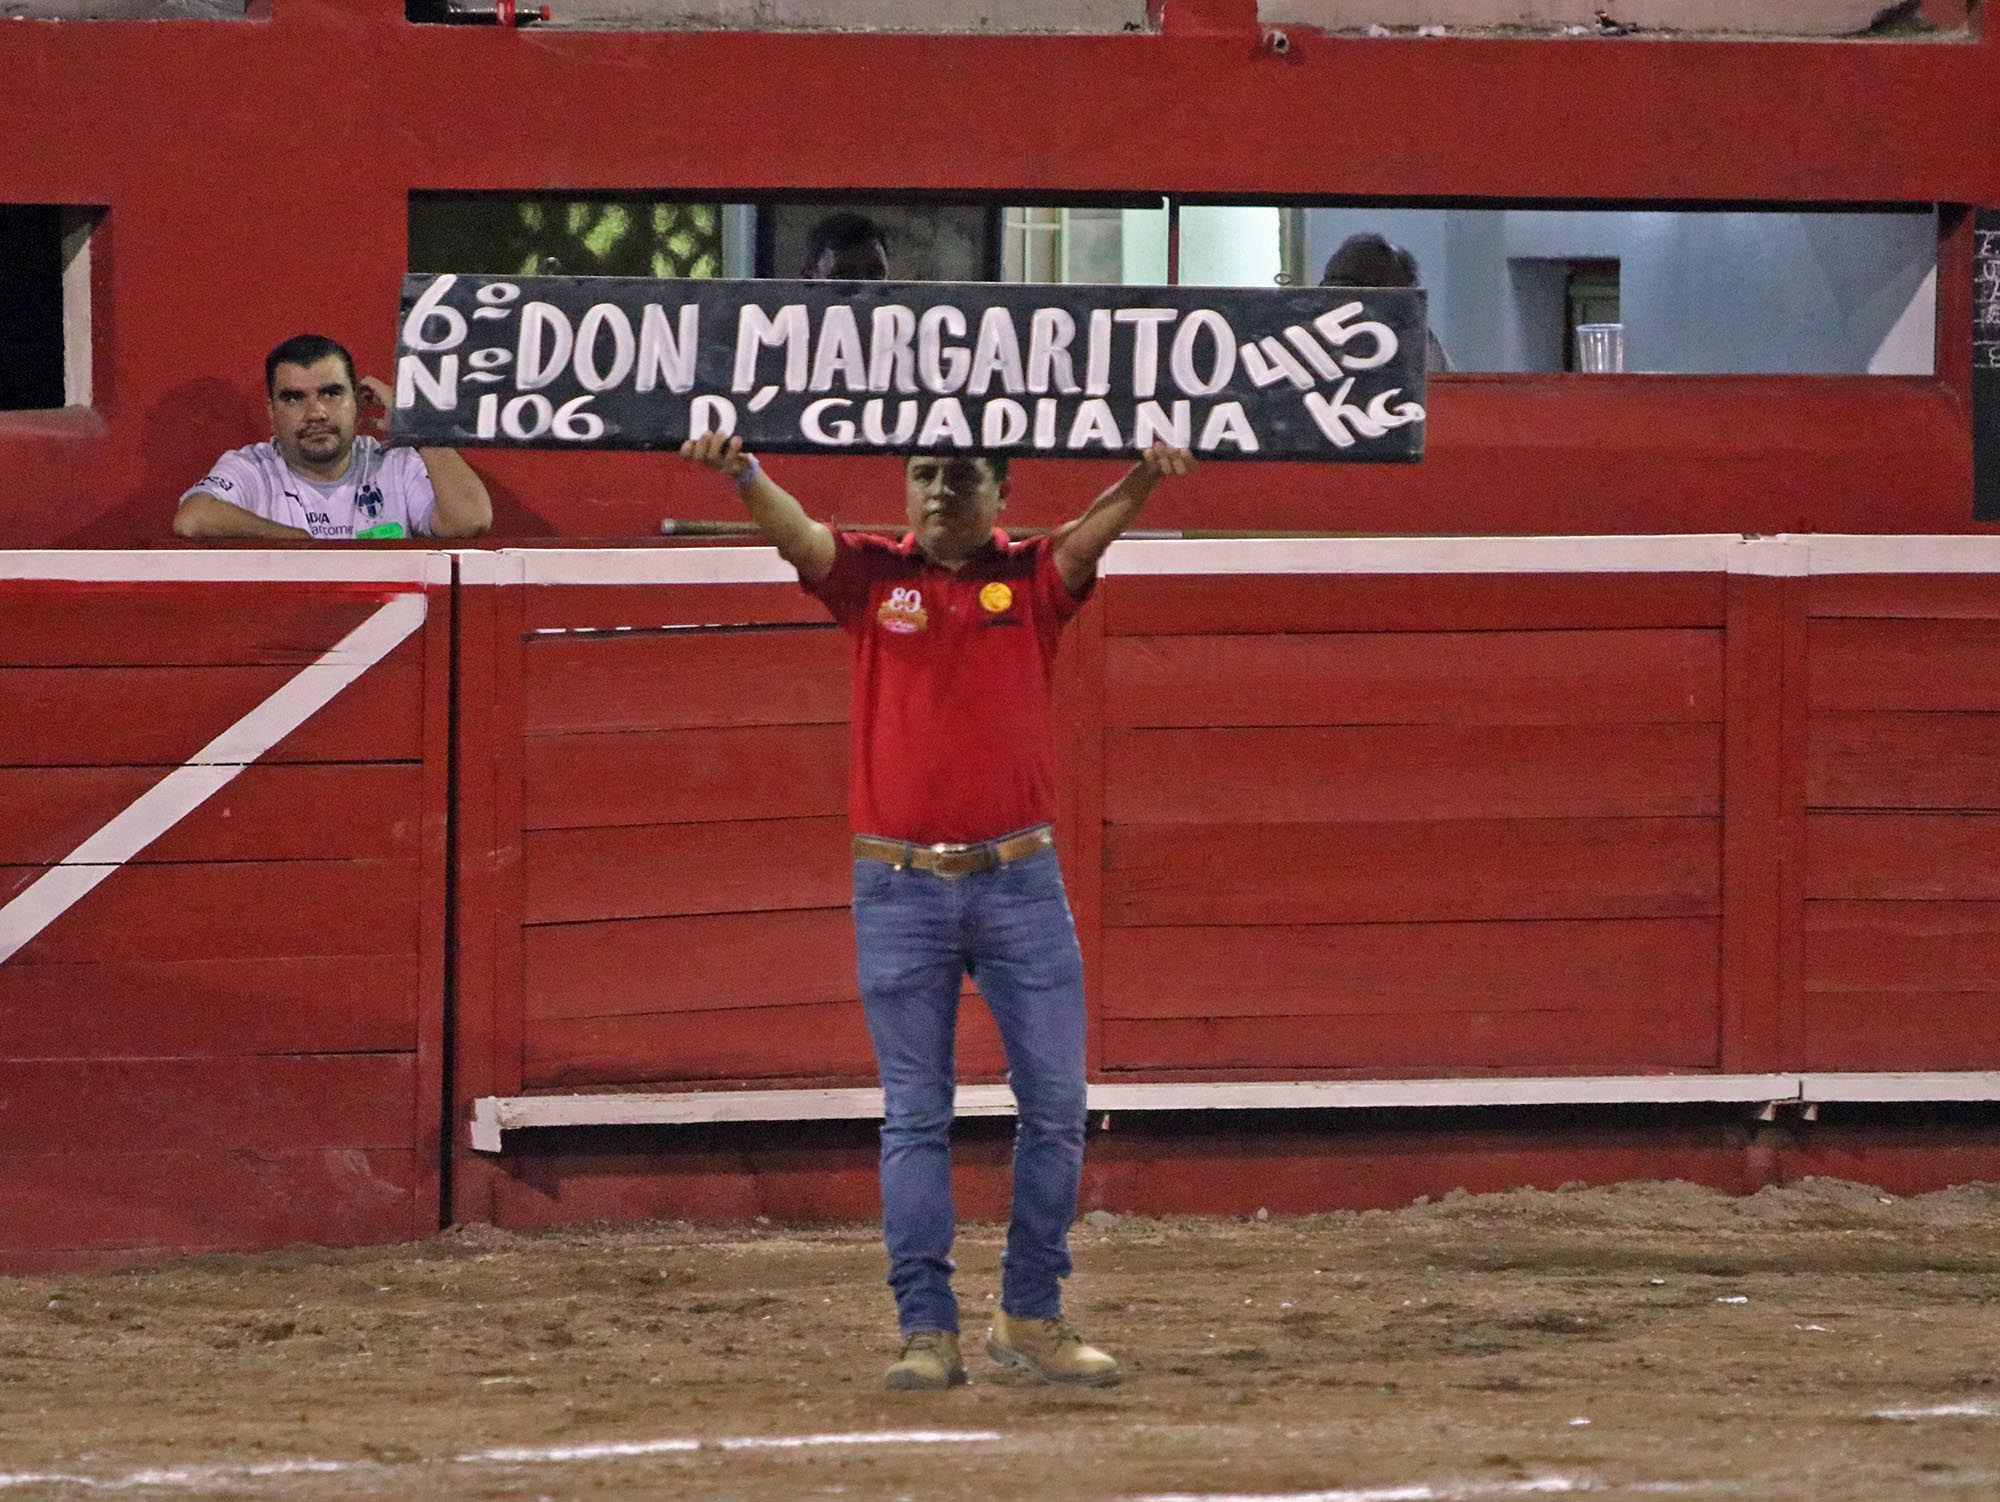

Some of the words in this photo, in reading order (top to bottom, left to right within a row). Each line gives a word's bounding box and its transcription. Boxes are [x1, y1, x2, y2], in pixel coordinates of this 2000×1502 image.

[516, 302, 699, 393] DON
[732, 303, 1237, 397] MARGARITO
[1240, 301, 1399, 390] 415
[477, 394, 604, 441] 106
[801, 398, 1259, 453] GUADIANA
[887, 587, 922, 614] 80
